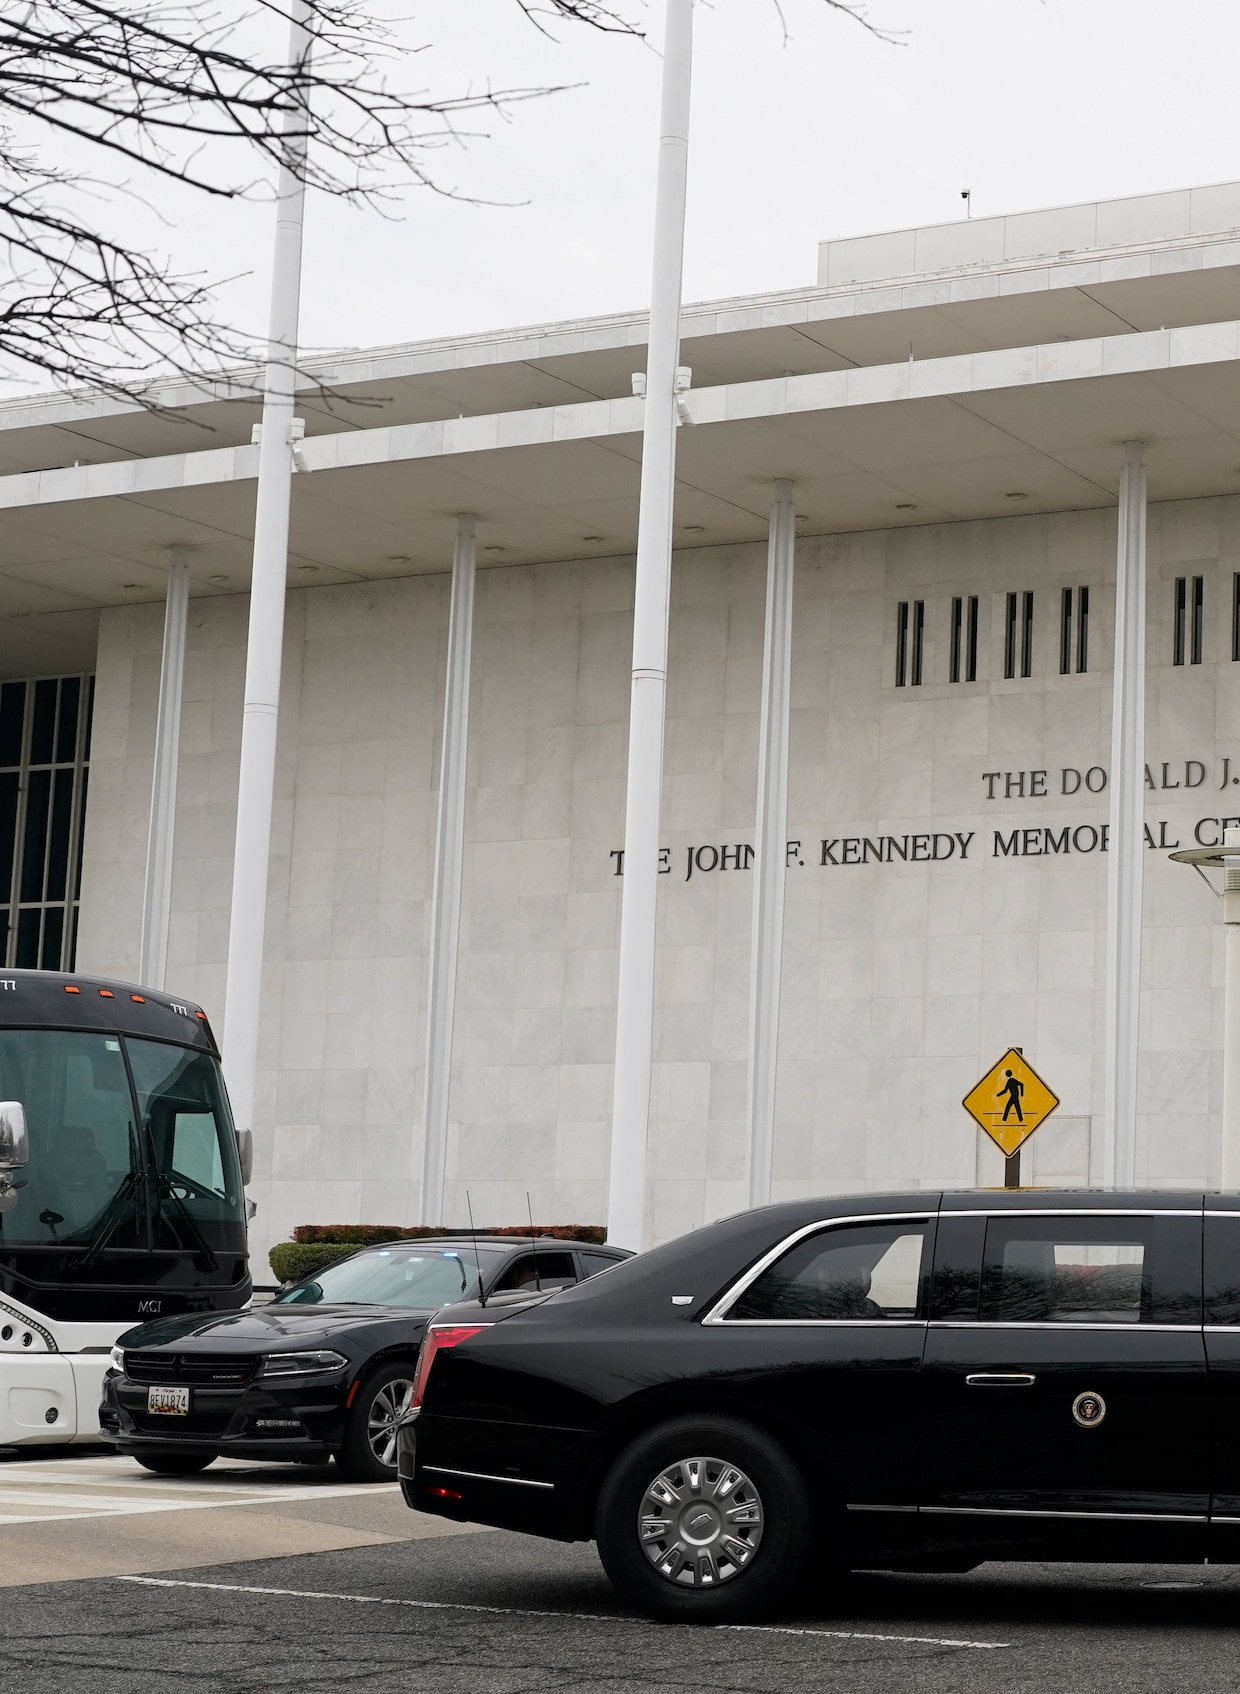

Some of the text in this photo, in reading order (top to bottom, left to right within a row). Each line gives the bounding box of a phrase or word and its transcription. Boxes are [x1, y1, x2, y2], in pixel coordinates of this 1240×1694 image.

[982, 770, 1048, 799] THE
[1060, 761, 1206, 795] DOALD
[1219, 758, 1240, 790] J.
[610, 848, 671, 876] TE
[786, 840, 805, 868] F.
[819, 831, 975, 866] KENNEDY
[992, 821, 1180, 857] MEMOAL
[170, 1003, 188, 1016] 777
[137, 1300, 162, 1313] MCI
